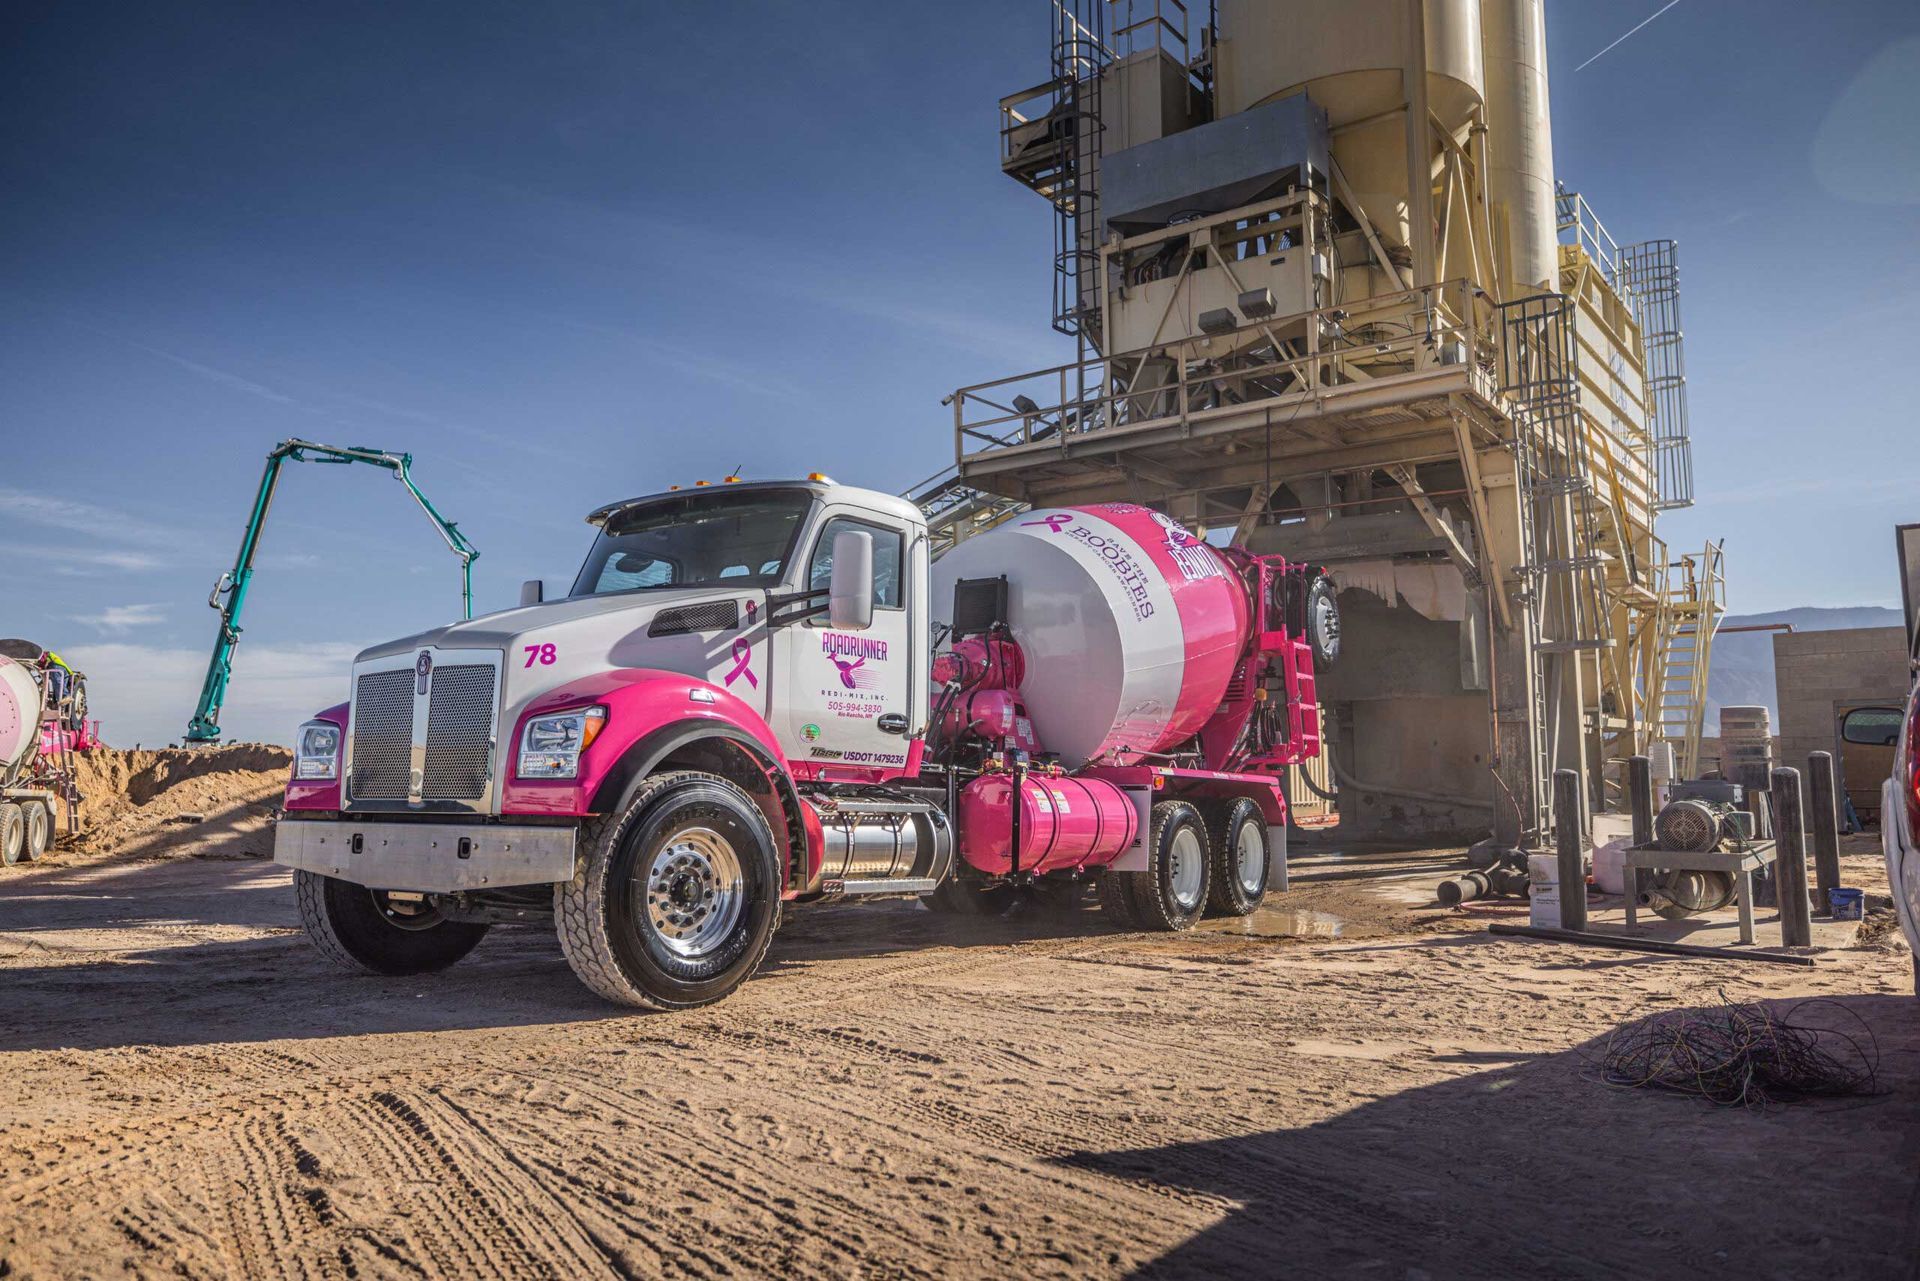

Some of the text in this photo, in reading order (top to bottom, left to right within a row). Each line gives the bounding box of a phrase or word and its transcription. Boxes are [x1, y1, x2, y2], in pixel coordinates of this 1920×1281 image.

[1069, 526, 1154, 618] BOOBIES
[1107, 538, 1132, 560] SAVE
[1133, 562, 1149, 584] THE
[524, 643, 557, 669] 78
[822, 631, 888, 661] ROADRUNNER
[827, 701, 882, 713] 505-994-3830
[843, 751, 873, 762] USDOT
[873, 753, 905, 764] 1479236
